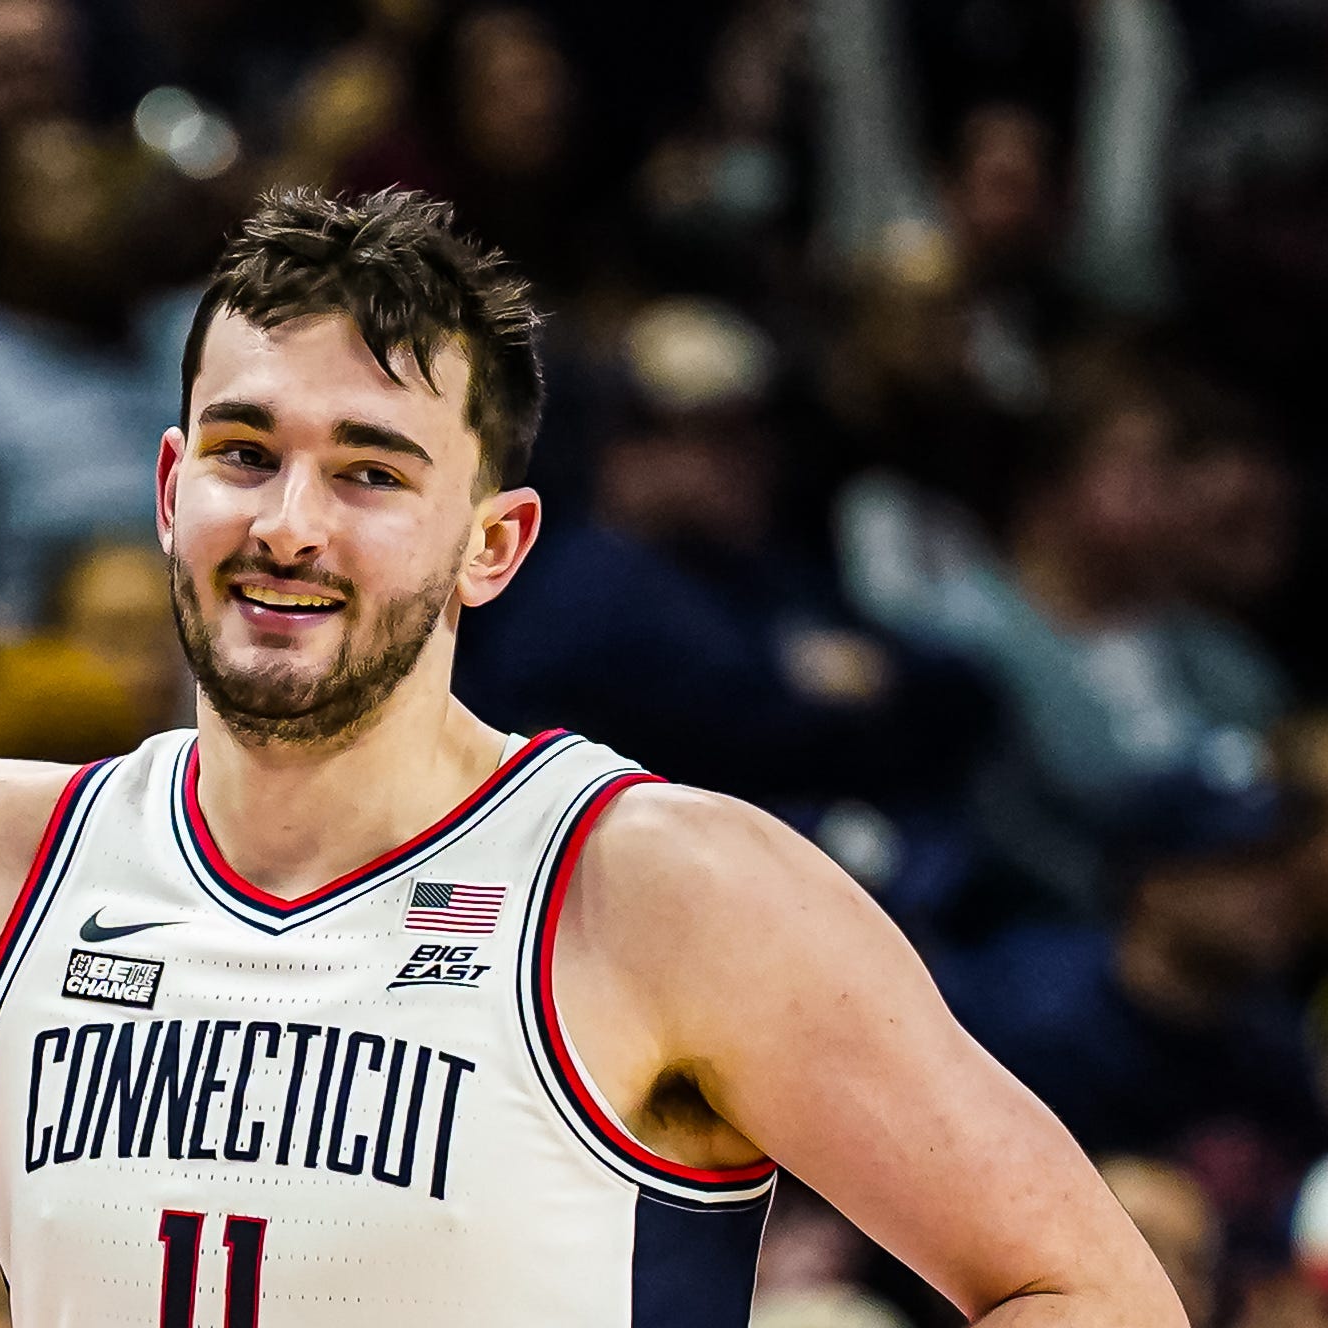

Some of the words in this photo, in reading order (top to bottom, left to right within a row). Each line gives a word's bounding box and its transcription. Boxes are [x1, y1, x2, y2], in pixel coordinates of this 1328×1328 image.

[409, 944, 479, 962] BIG
[395, 963, 492, 980] EAST
[66, 975, 153, 1002] CHANGE
[25, 1019, 476, 1200] CONNECTICUT
